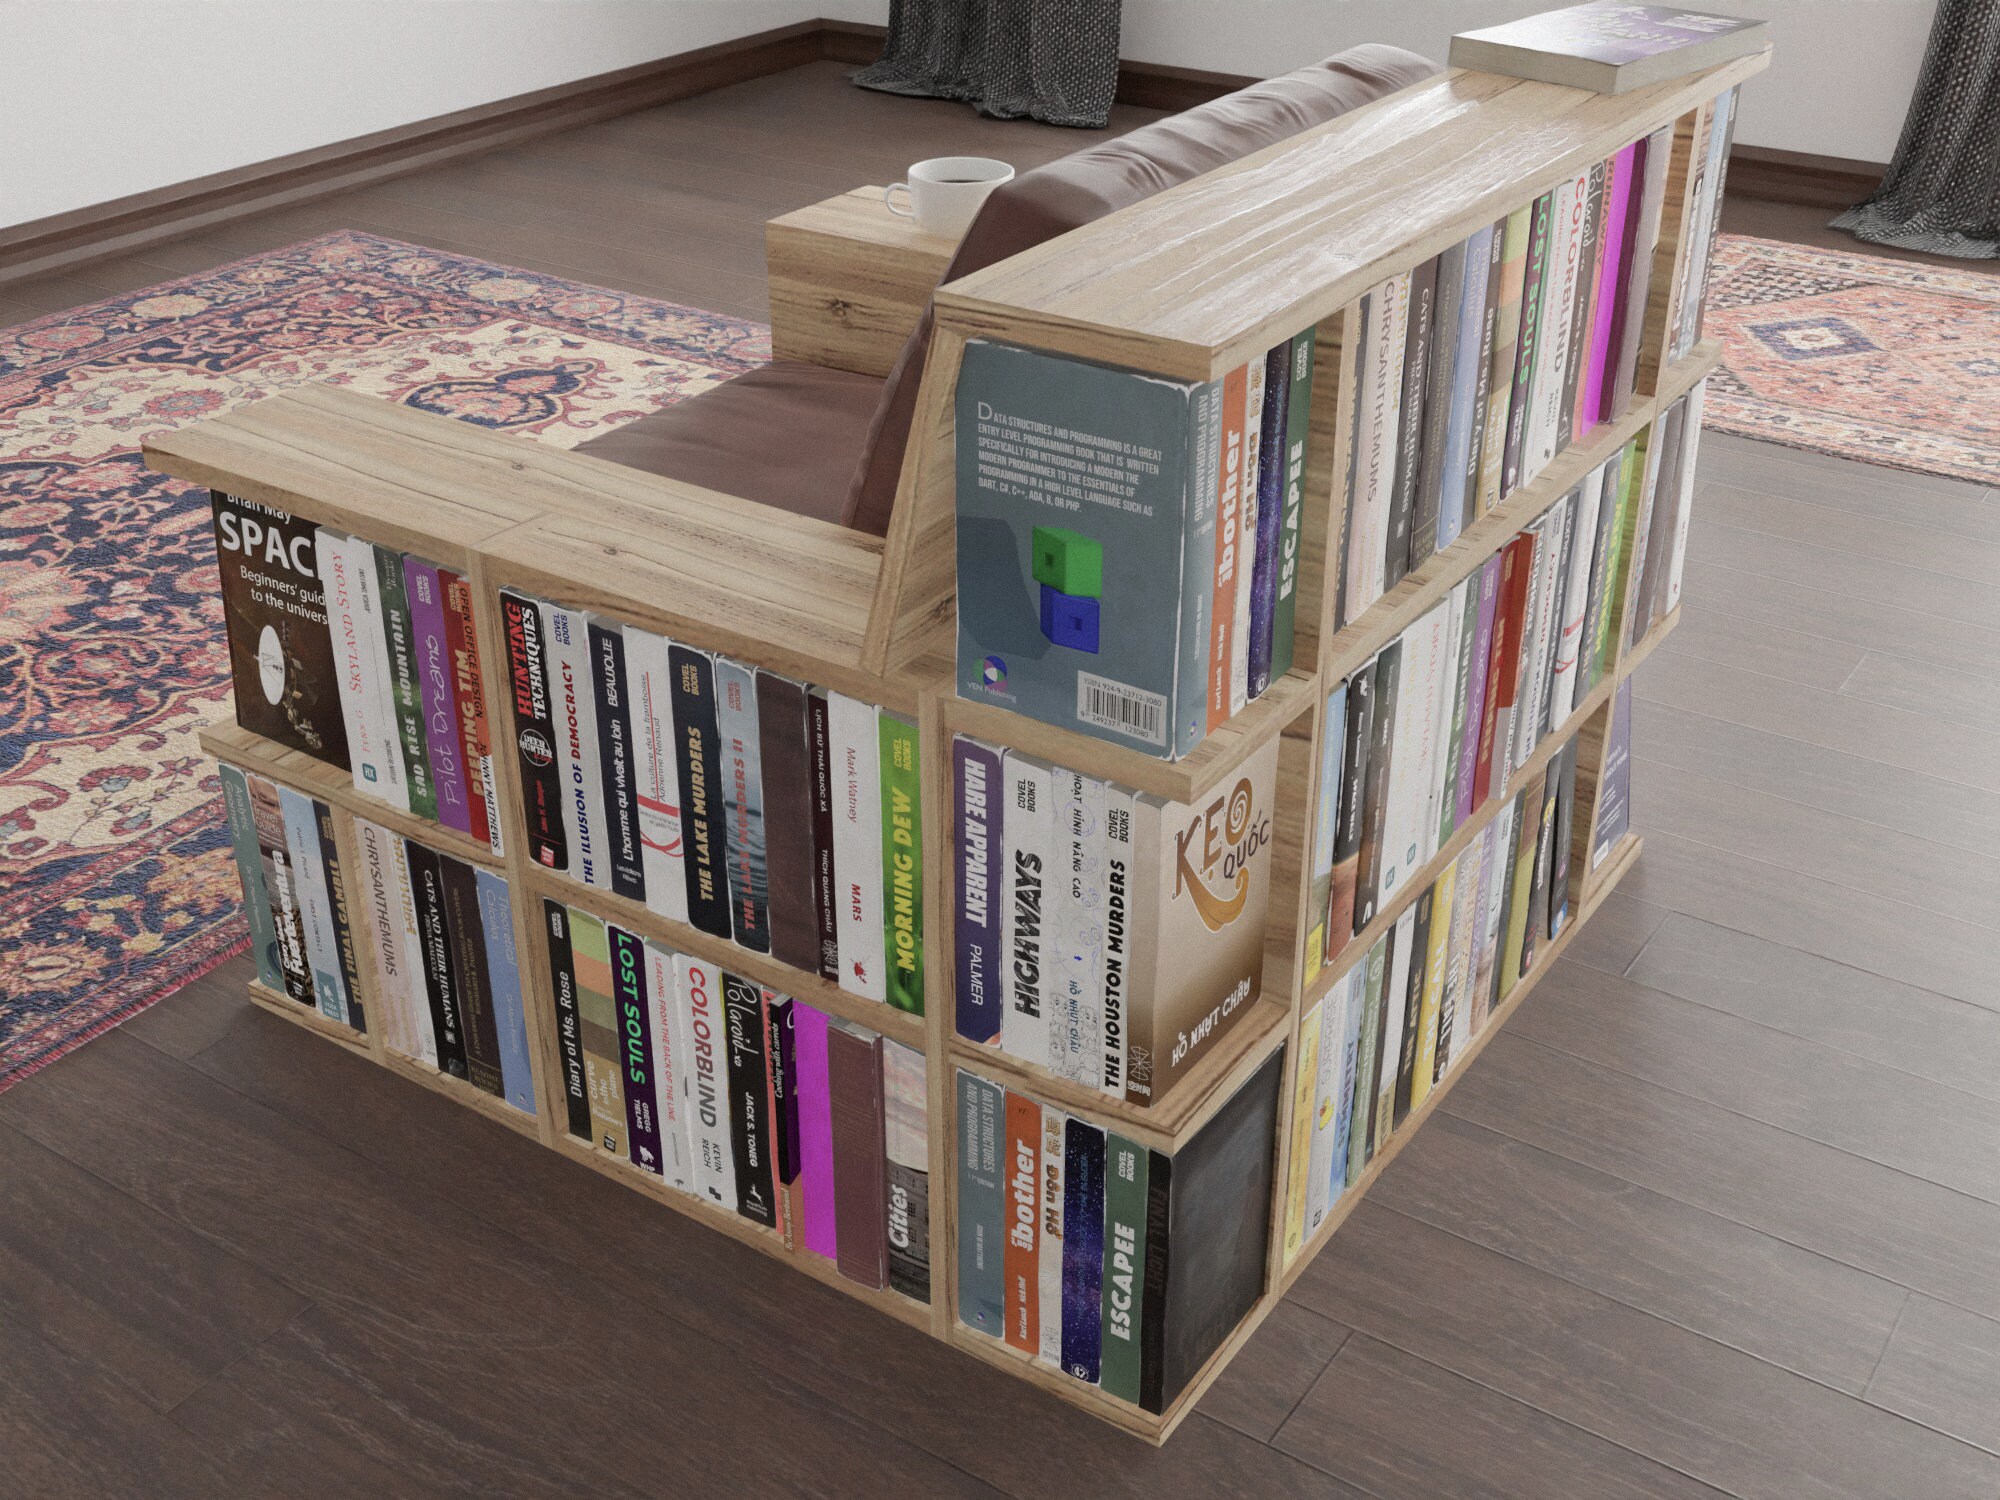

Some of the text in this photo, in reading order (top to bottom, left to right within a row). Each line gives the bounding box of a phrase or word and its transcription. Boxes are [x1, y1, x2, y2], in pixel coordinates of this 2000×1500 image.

[1519, 195, 1549, 385] LOST SOULS
[1554, 177, 1585, 374] COLORBLIND
[1366, 281, 1395, 502] CHRYSANTHEMUMS
[978, 423, 1159, 475] ENTRY LEVEL PROGRAMMING BOOK THAT IS WRITTEN
[978, 436, 1140, 485] SPECIFICALLY FOR INTRODUCING A MODERN THE
[1008, 416, 1052, 435] STRUCTURES
[1053, 428, 1068, 439] AND
[1069, 431, 1122, 452] PROGRAMMING
[1123, 443, 1131, 454] IS
[1131, 445, 1138, 455] A
[1138, 446, 1162, 461] GREAT
[978, 450, 1136, 498] MODERN PROGRAMMER TO THE ESSENTIALS OF
[978, 463, 1028, 485] PROGRAMMING
[1029, 476, 1037, 487] IN
[1044, 480, 1061, 493] HIGH
[1062, 485, 1083, 499] LEVEL
[1084, 490, 1121, 509] LANGUAGE
[1122, 499, 1142, 514] SUCH
[1143, 505, 1153, 517] AS
[219, 511, 315, 578] SPAC
[1279, 440, 1303, 600] ESCAPEE
[240, 564, 327, 607] Beginners' guid
[251, 587, 329, 625] to the univers
[415, 574, 424, 602] COVEL
[422, 575, 431, 605] BOOKS
[332, 550, 362, 694] SKYLAND STORY
[552, 612, 562, 644] COVEL
[560, 614, 570, 646] BOOKS
[390, 609, 413, 707] MOUNTAIN
[460, 588, 483, 718] OPEN OFFICE DESIGN
[505, 602, 532, 718] HUNTING
[520, 606, 546, 720] TECHNIQUES
[601, 637, 618, 707] BEAUJOLIE
[681, 662, 690, 693] COVEL
[689, 665, 699, 696] BOOKS
[404, 714, 420, 756] RISE
[461, 701, 485, 797] PEEPING
[611, 718, 622, 740] loin
[614, 742, 623, 757] au
[893, 738, 902, 768] COVEL
[902, 739, 911, 771] BOOKS
[413, 764, 427, 797] SAD
[479, 743, 500, 848] JOHNNY MATTHEWS
[560, 659, 595, 885] THE ILLUSION OF DEMOCRACY
[613, 757, 626, 789] vivait
[846, 746, 858, 824] Mark Watney
[1018, 779, 1027, 808] COVEL
[1027, 780, 1036, 812] BOOKS
[615, 790, 629, 809] qui
[687, 725, 714, 902] THE LAKE MURDERS
[1108, 808, 1119, 839] COVEL
[619, 808, 634, 861] L'homme
[964, 757, 988, 928] HARE APPARENT
[1119, 810, 1129, 843] BOOKS
[364, 826, 397, 977] CHRYSANTHEMUMS
[851, 882, 862, 922] MARS
[887, 786, 916, 972] MORNING DEW
[1071, 877, 1080, 899] CAO
[485, 889, 499, 941] Calculus
[499, 896, 519, 966] Theoretical
[1014, 849, 1043, 1019] HIGHWAYS
[424, 868, 455, 1028] CATS AND THEIR HUMANS
[1104, 859, 1126, 1089] THE HOUSTON MURDERS
[655, 957, 664, 1000] LEADING
[969, 944, 984, 1006] PALMER
[617, 932, 647, 1085] LOST SOULS
[559, 971, 583, 1099] Diary of Ms. Rose
[660, 1025, 669, 1045] THE
[662, 1045, 671, 1070] BACK
[689, 966, 717, 1128] COLORBLIND
[665, 1071, 672, 1085] OF
[665, 1085, 673, 1104] THE
[642, 1101, 653, 1133] GREGG
[966, 1082, 979, 1171] AND PROGRAMMING
[982, 1088, 995, 1173] DATA STRUCTURES
[701, 1138, 711, 1168] REICH
[712, 1142, 723, 1174] KEVIN
[1118, 1151, 1128, 1178] COVEL
[1126, 1152, 1135, 1182] BOOKS
[887, 1184, 910, 1248] Cities
[1011, 1138, 1034, 1242] bother
[1110, 1222, 1137, 1341] ESCAPEE
